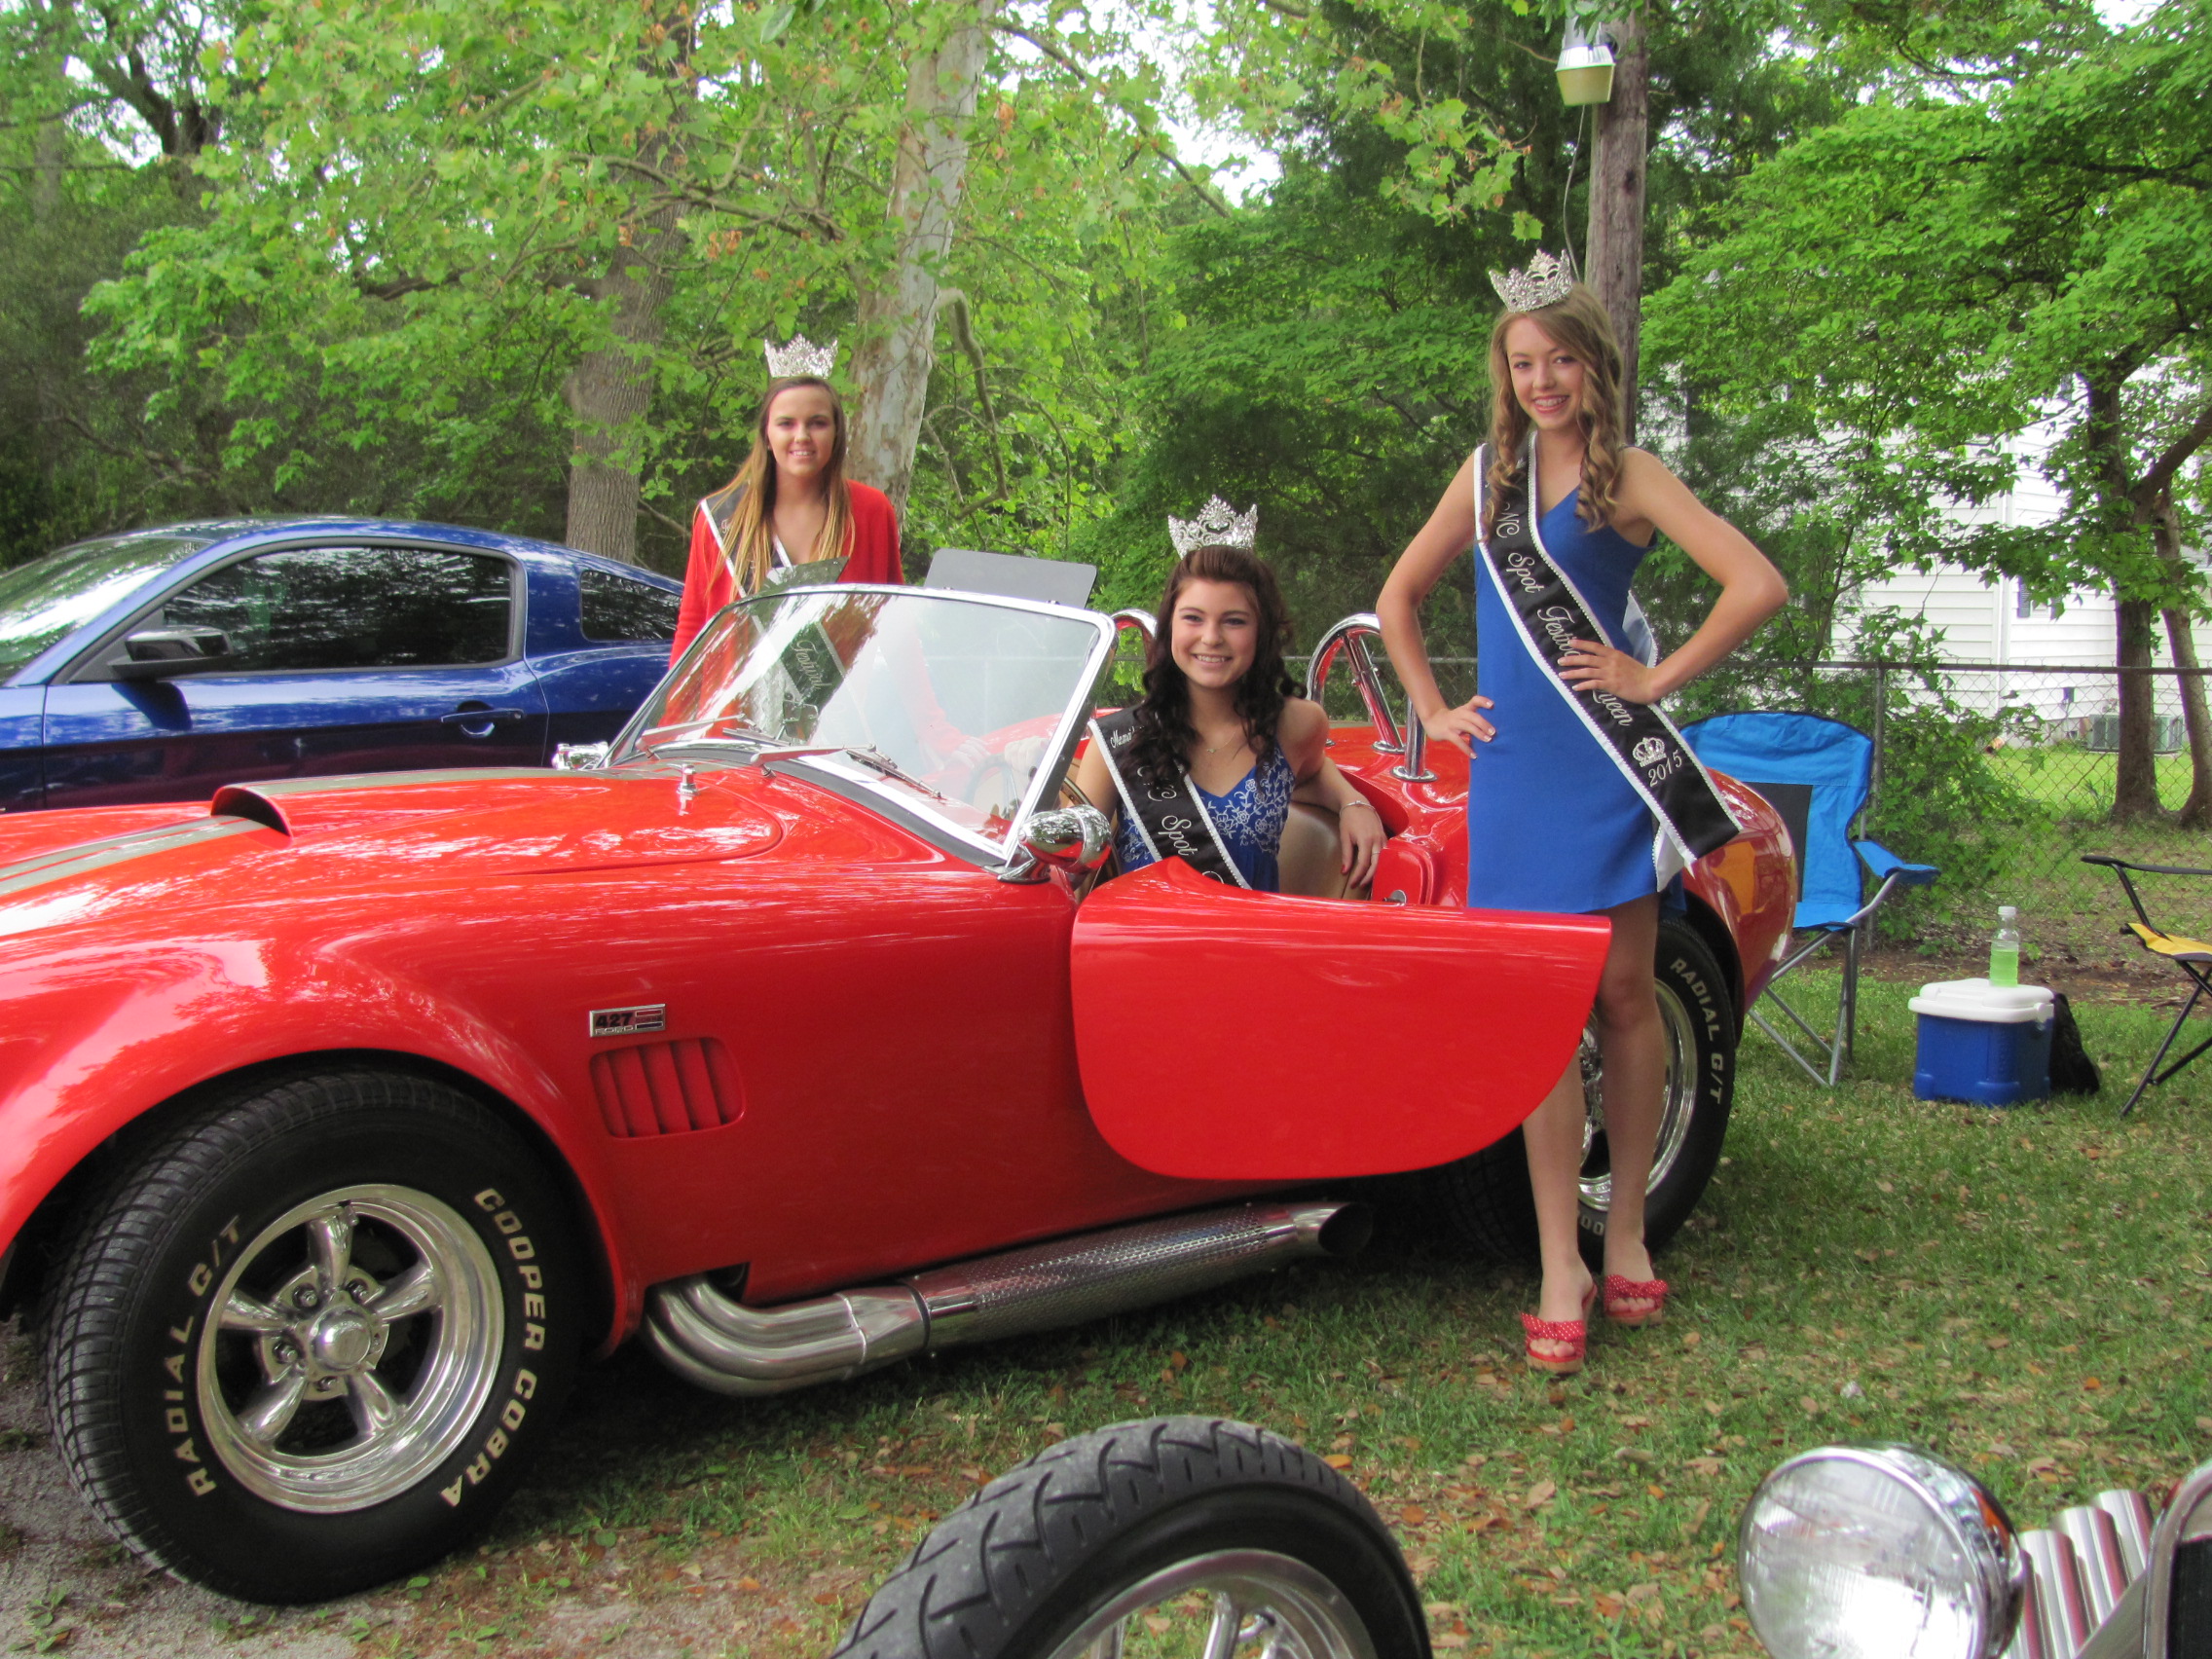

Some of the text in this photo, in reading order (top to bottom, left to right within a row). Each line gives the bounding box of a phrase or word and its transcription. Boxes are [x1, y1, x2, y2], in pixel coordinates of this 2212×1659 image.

[1506, 552, 1544, 594] Spot
[1537, 606, 1581, 658] Festiv
[1648, 749, 1683, 788] 2015
[1158, 815, 1198, 856] Spot
[595, 1013, 634, 1027] 427
[1670, 957, 1724, 1105] RADIAL G/T
[165, 1214, 240, 1496] RADIAL G/T
[440, 1188, 546, 1506] COOPER COBRA
